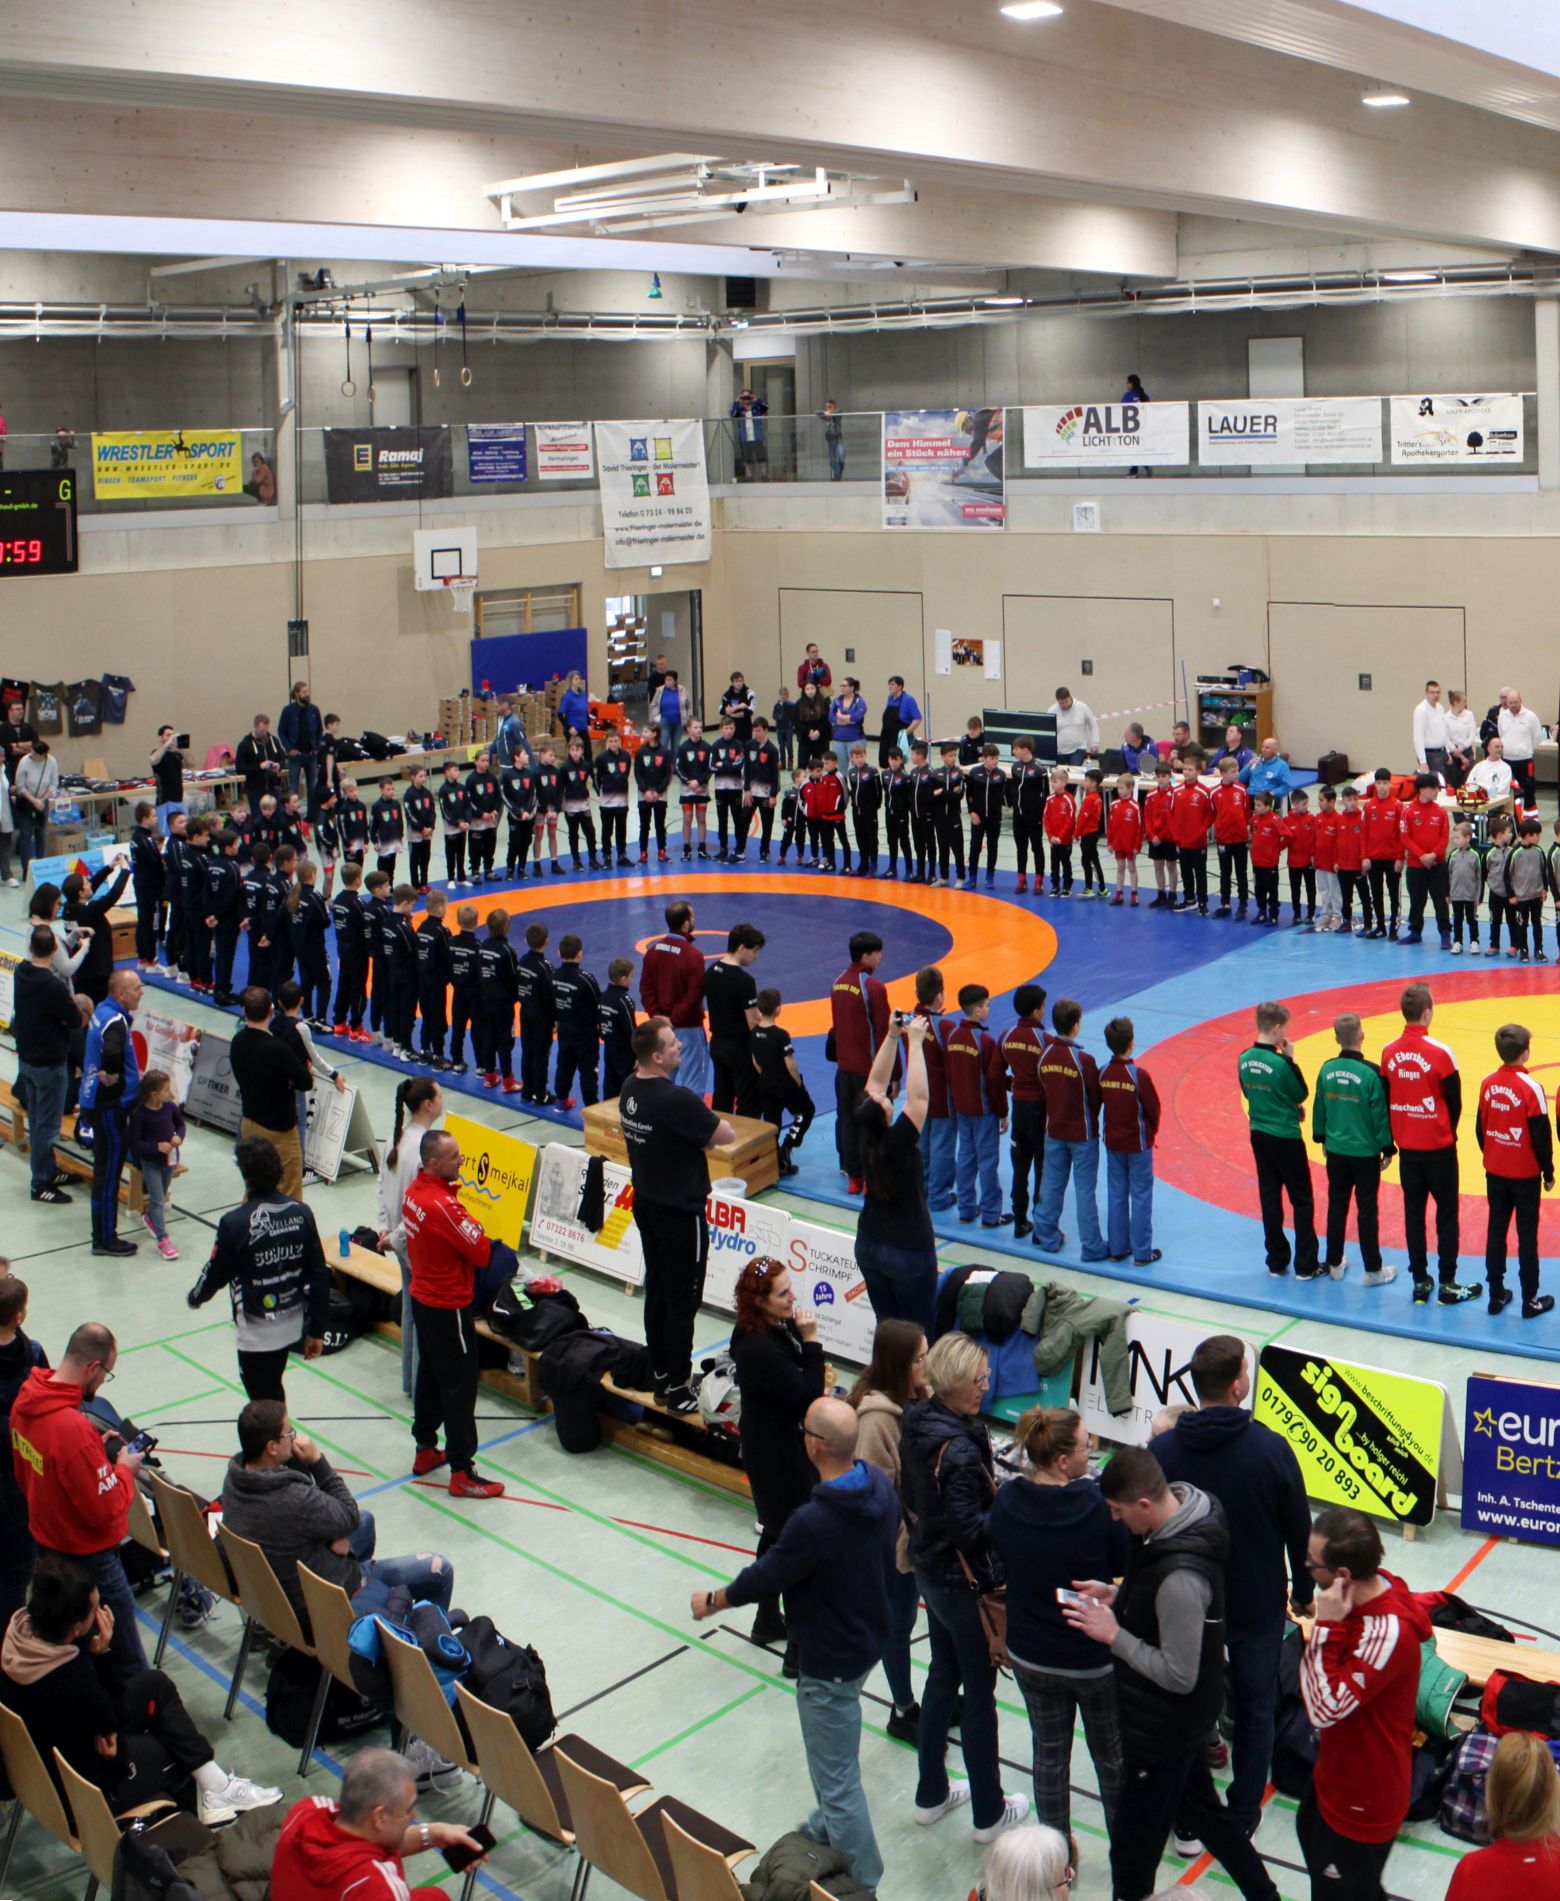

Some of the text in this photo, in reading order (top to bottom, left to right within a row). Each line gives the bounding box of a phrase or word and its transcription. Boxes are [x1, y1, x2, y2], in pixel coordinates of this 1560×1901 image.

[1083, 405, 1140, 434] ALB
[1208, 415, 1277, 433] LAUER
[887, 439, 952, 448] Dem Himmel
[1083, 435, 1140, 447] LICHT TON
[97, 442, 236, 461] WRESTLER SPORT
[887, 448, 969, 458] ein Stück näher.
[58, 480, 72, 501] G
[490, 1166, 530, 1193] mejkal
[1262, 1387, 1361, 1500] 0179 90 20 893
[1478, 1491, 1497, 1504] Inh.
[1499, 1496, 1512, 1507] A.
